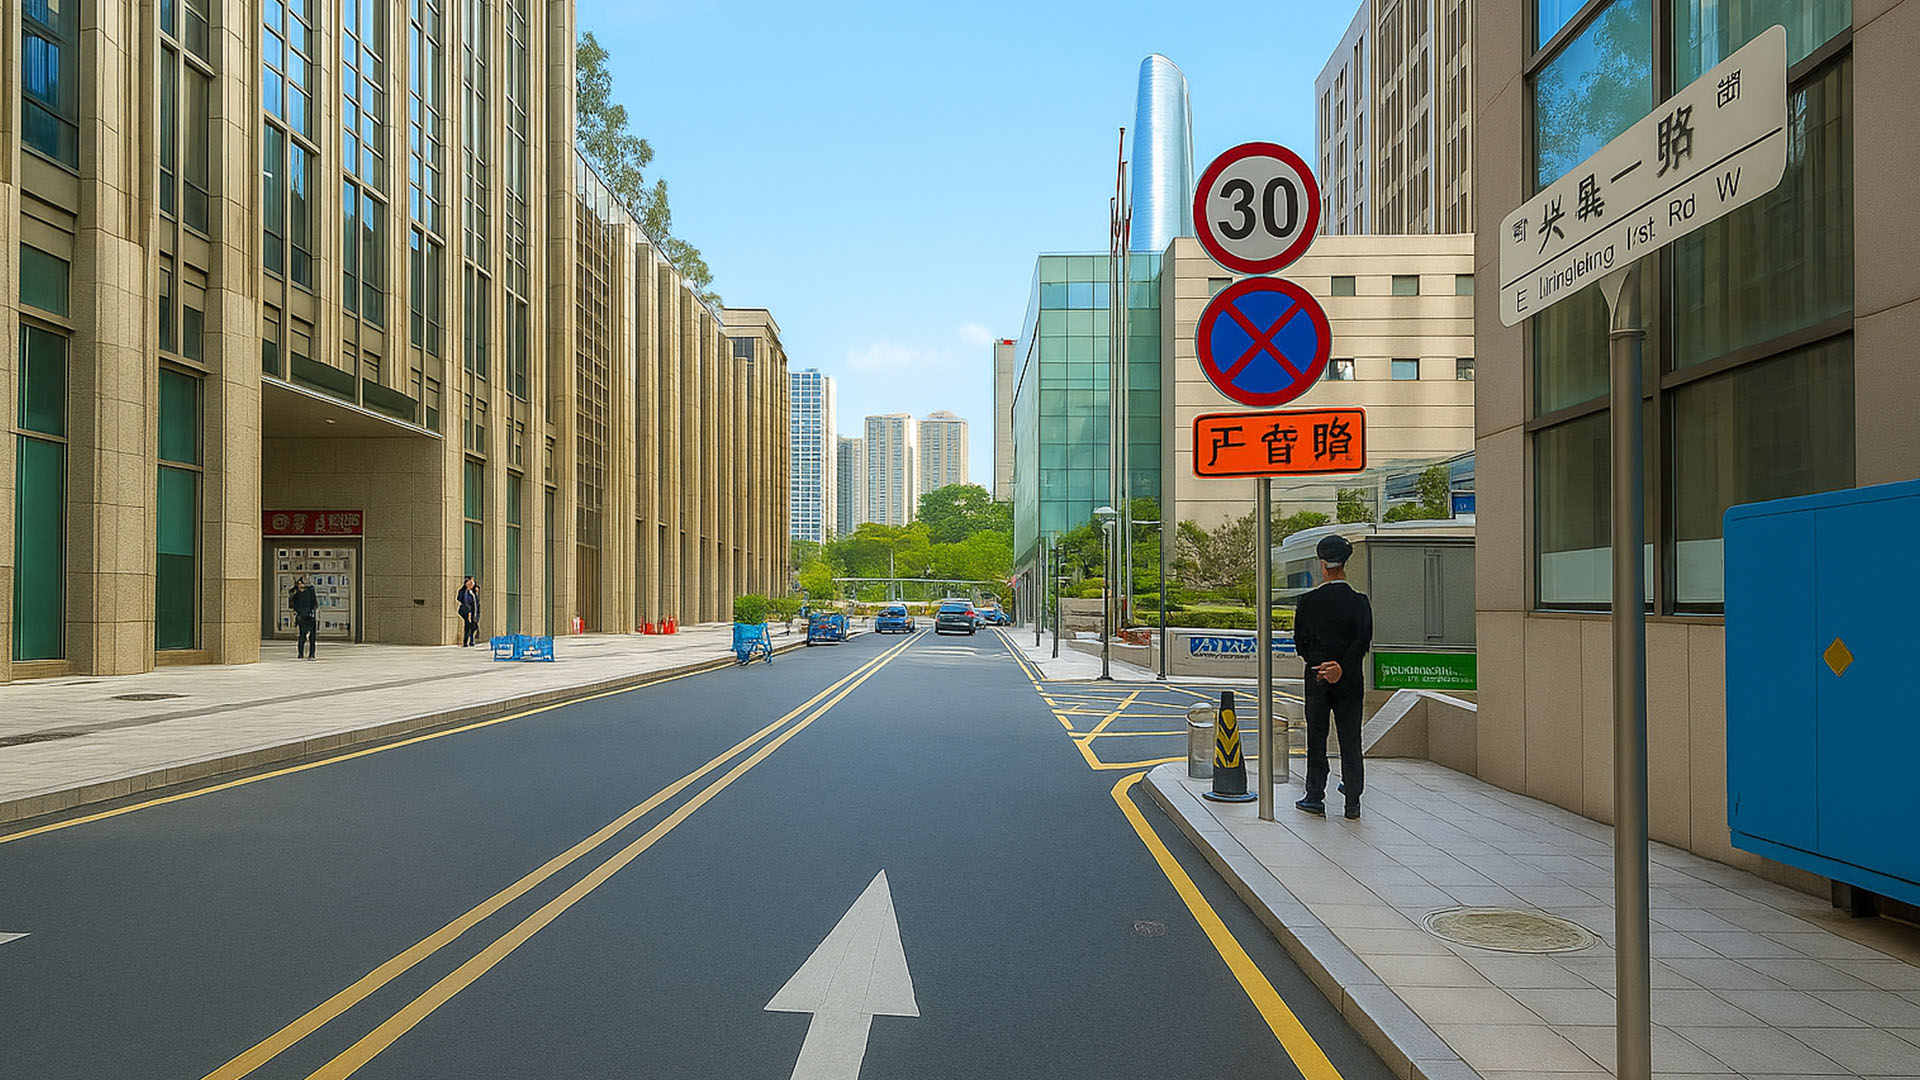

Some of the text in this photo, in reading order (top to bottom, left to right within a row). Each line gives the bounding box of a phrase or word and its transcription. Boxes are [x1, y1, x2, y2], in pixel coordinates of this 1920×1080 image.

[1217, 176, 1299, 240] 30
[1516, 289, 1528, 313] E
[1668, 192, 1696, 227] Rd
[1716, 166, 1741, 202] W
